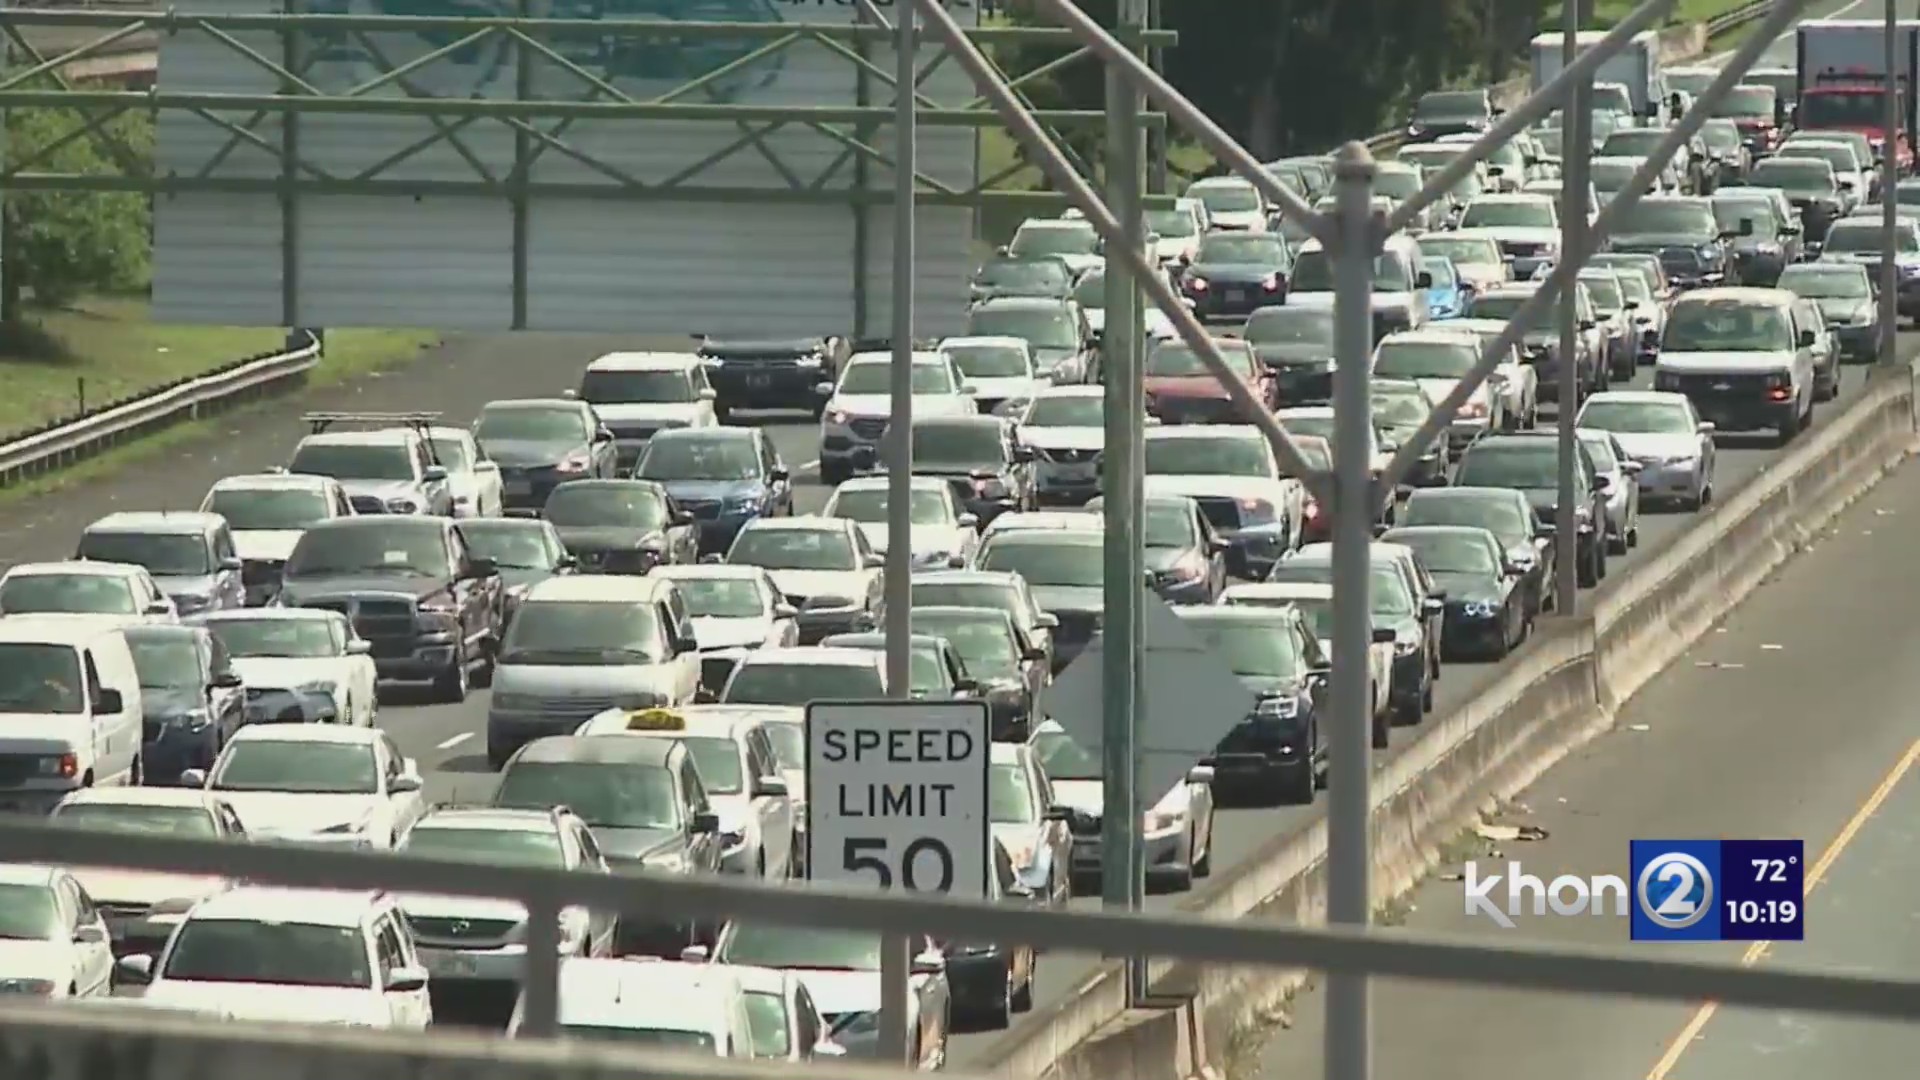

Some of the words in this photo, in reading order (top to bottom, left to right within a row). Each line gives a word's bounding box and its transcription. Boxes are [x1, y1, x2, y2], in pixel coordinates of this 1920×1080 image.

[822, 728, 973, 762] SPEED
[839, 783, 955, 817] LIMIT
[843, 836, 954, 895] 50
